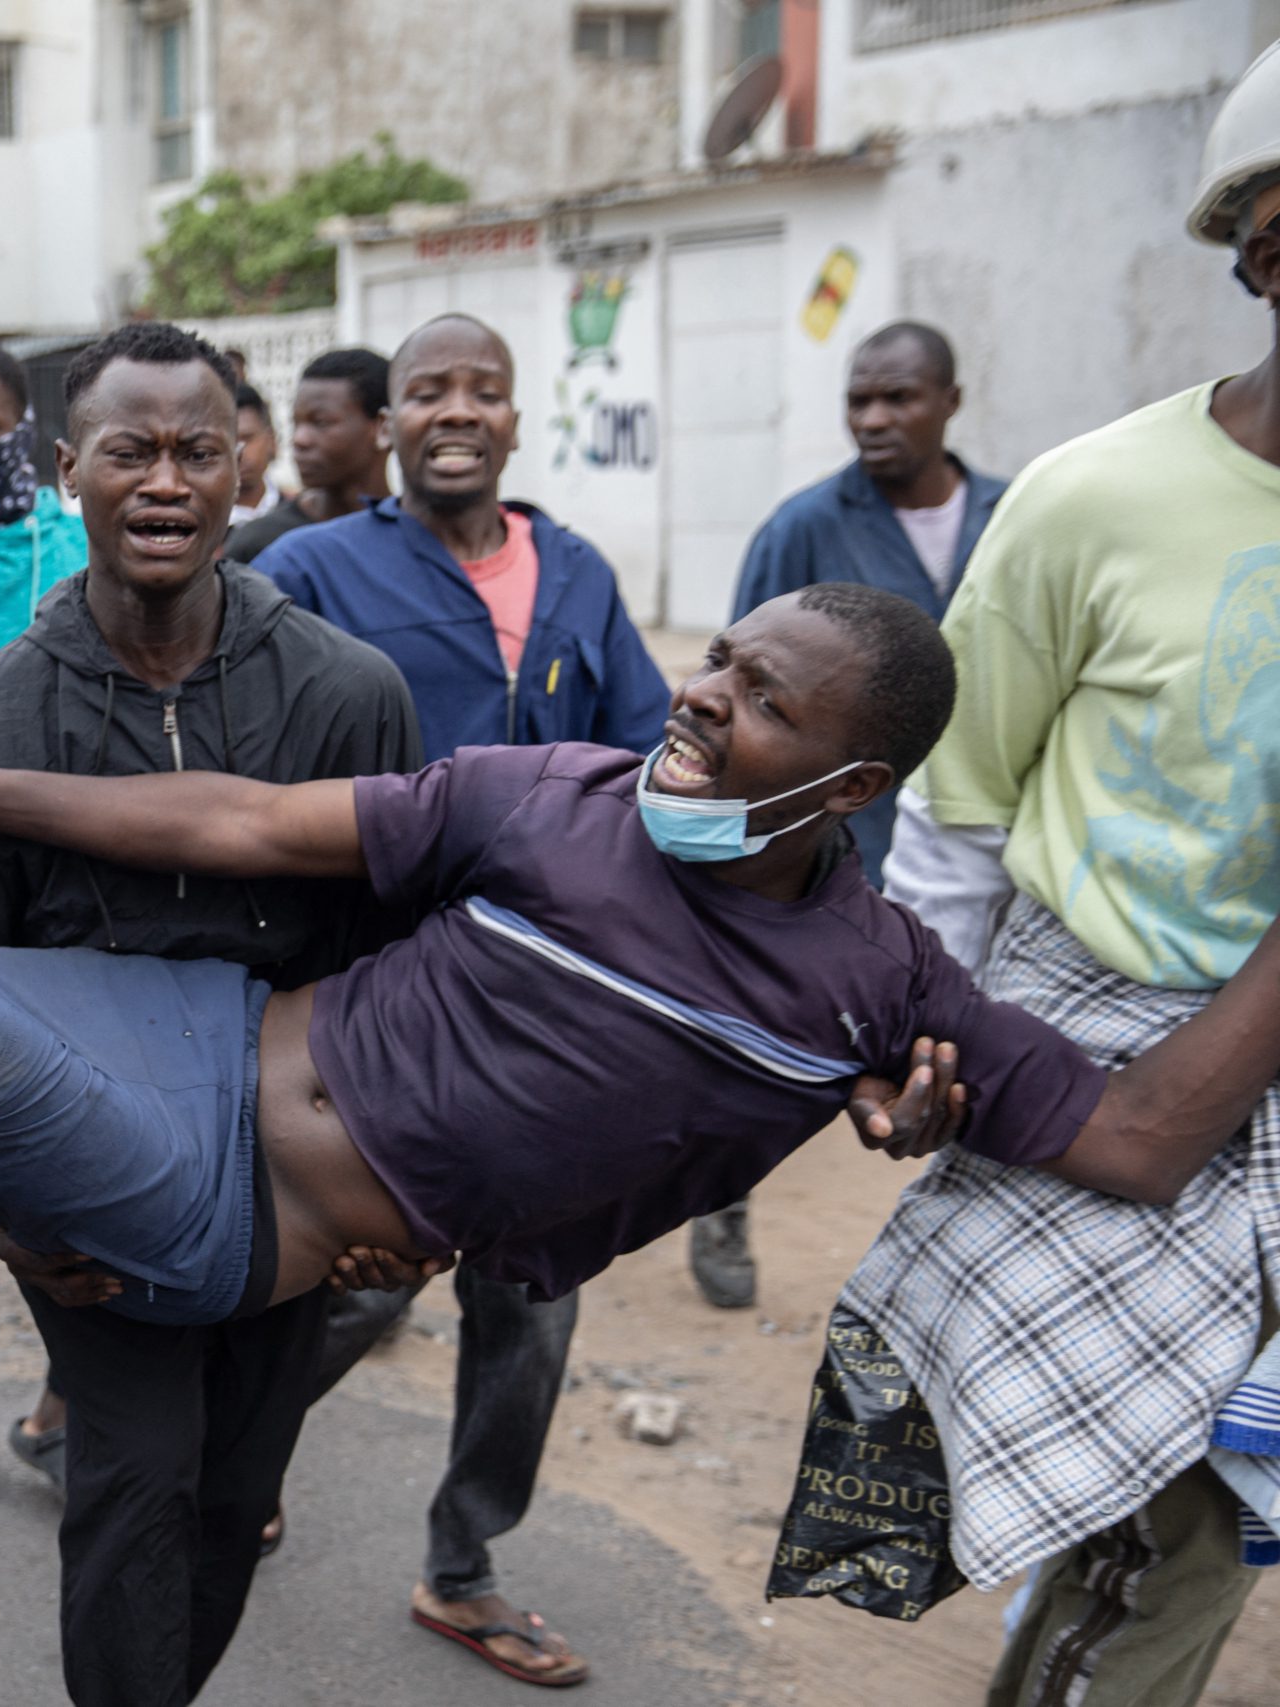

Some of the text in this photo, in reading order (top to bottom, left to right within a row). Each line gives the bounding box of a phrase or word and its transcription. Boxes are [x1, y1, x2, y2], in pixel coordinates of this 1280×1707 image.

[842, 1357, 902, 1377] GOOD
[902, 1421, 937, 1450] IS
[856, 1441, 889, 1463] IT
[803, 1500, 895, 1533] ALWAYS
